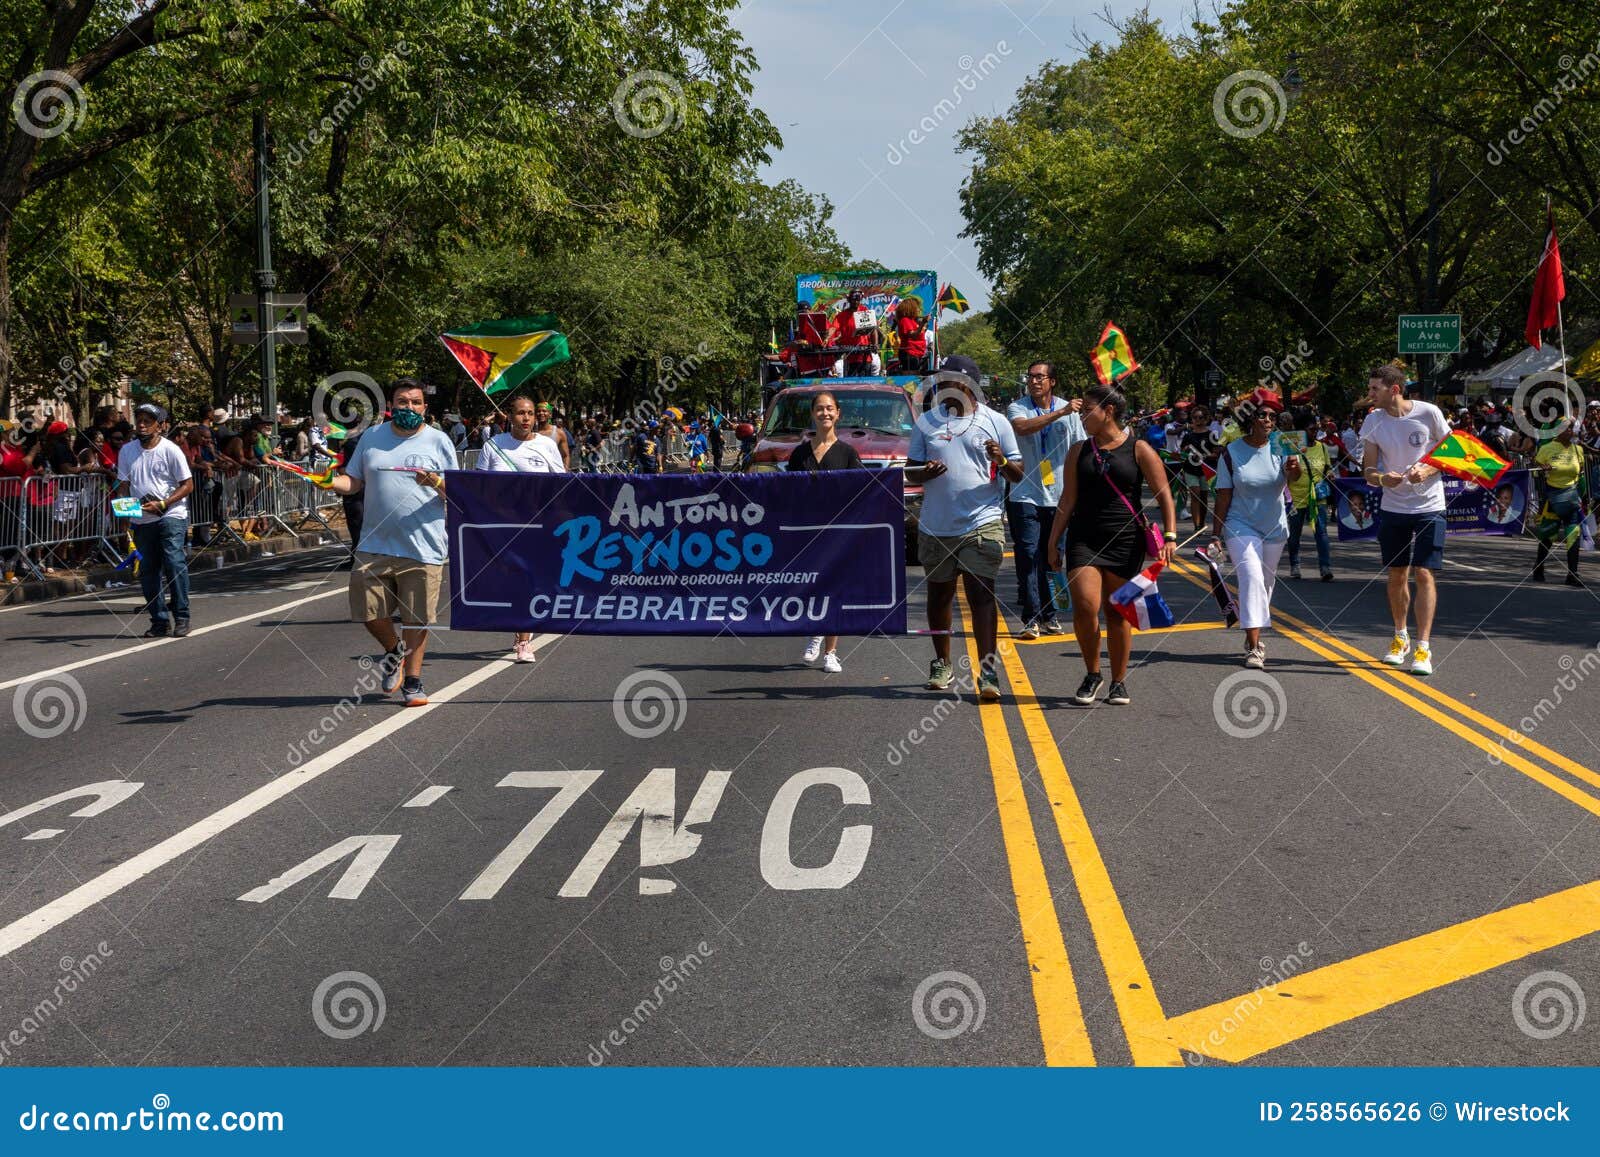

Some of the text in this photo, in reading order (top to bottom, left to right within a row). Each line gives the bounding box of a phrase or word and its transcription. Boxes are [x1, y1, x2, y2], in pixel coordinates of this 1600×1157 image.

[800, 280, 842, 289] BROOKLYN
[1402, 320, 1458, 329] Nostrand
[1418, 331, 1441, 340] Ave
[1407, 342, 1451, 350] NEXT SIGNAL
[609, 482, 765, 529] ANTONIO
[553, 515, 774, 587] REYNOSO
[610, 571, 819, 586] BROOKLYN BOROUGH PRESIDENT
[529, 594, 830, 621] CELEBRATES YOU
